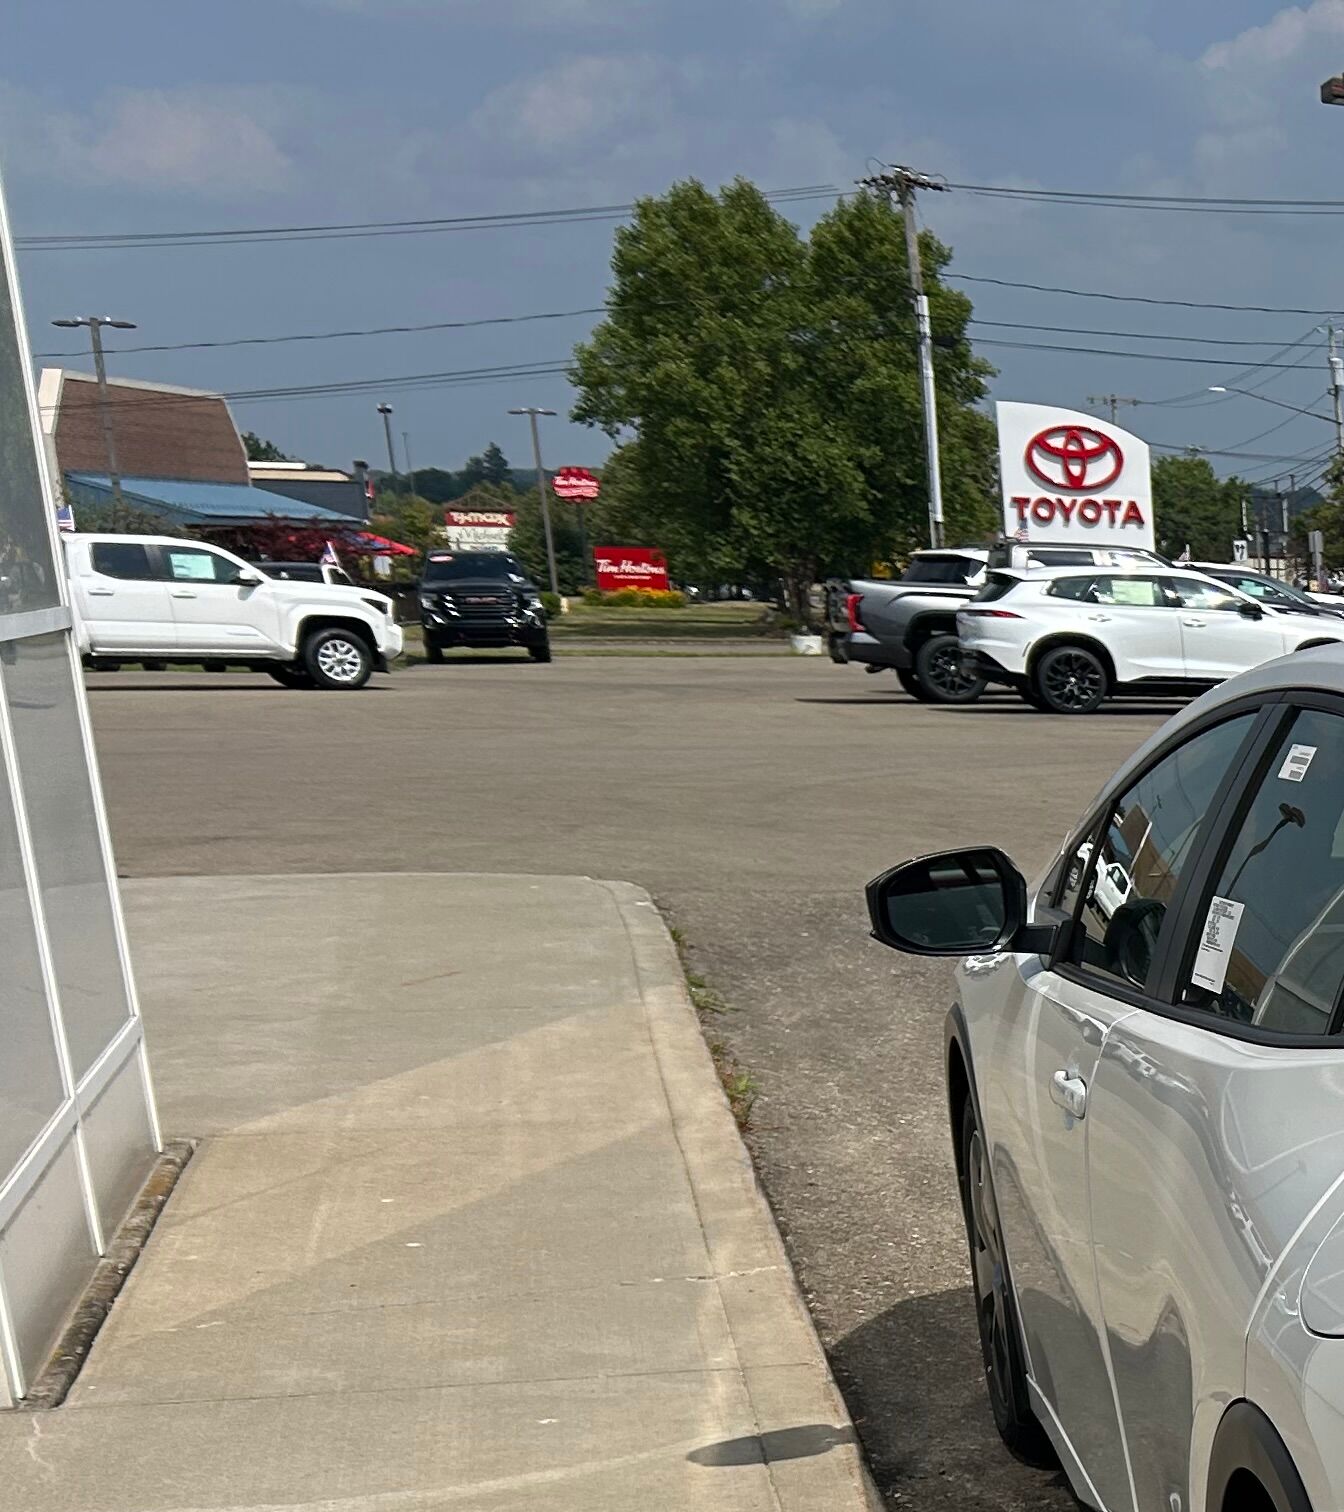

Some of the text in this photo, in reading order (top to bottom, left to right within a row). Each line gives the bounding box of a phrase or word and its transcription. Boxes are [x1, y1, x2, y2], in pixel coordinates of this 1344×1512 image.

[1010, 497, 1145, 529] TOYOTA
[596, 559, 667, 575] Tim Hortons
